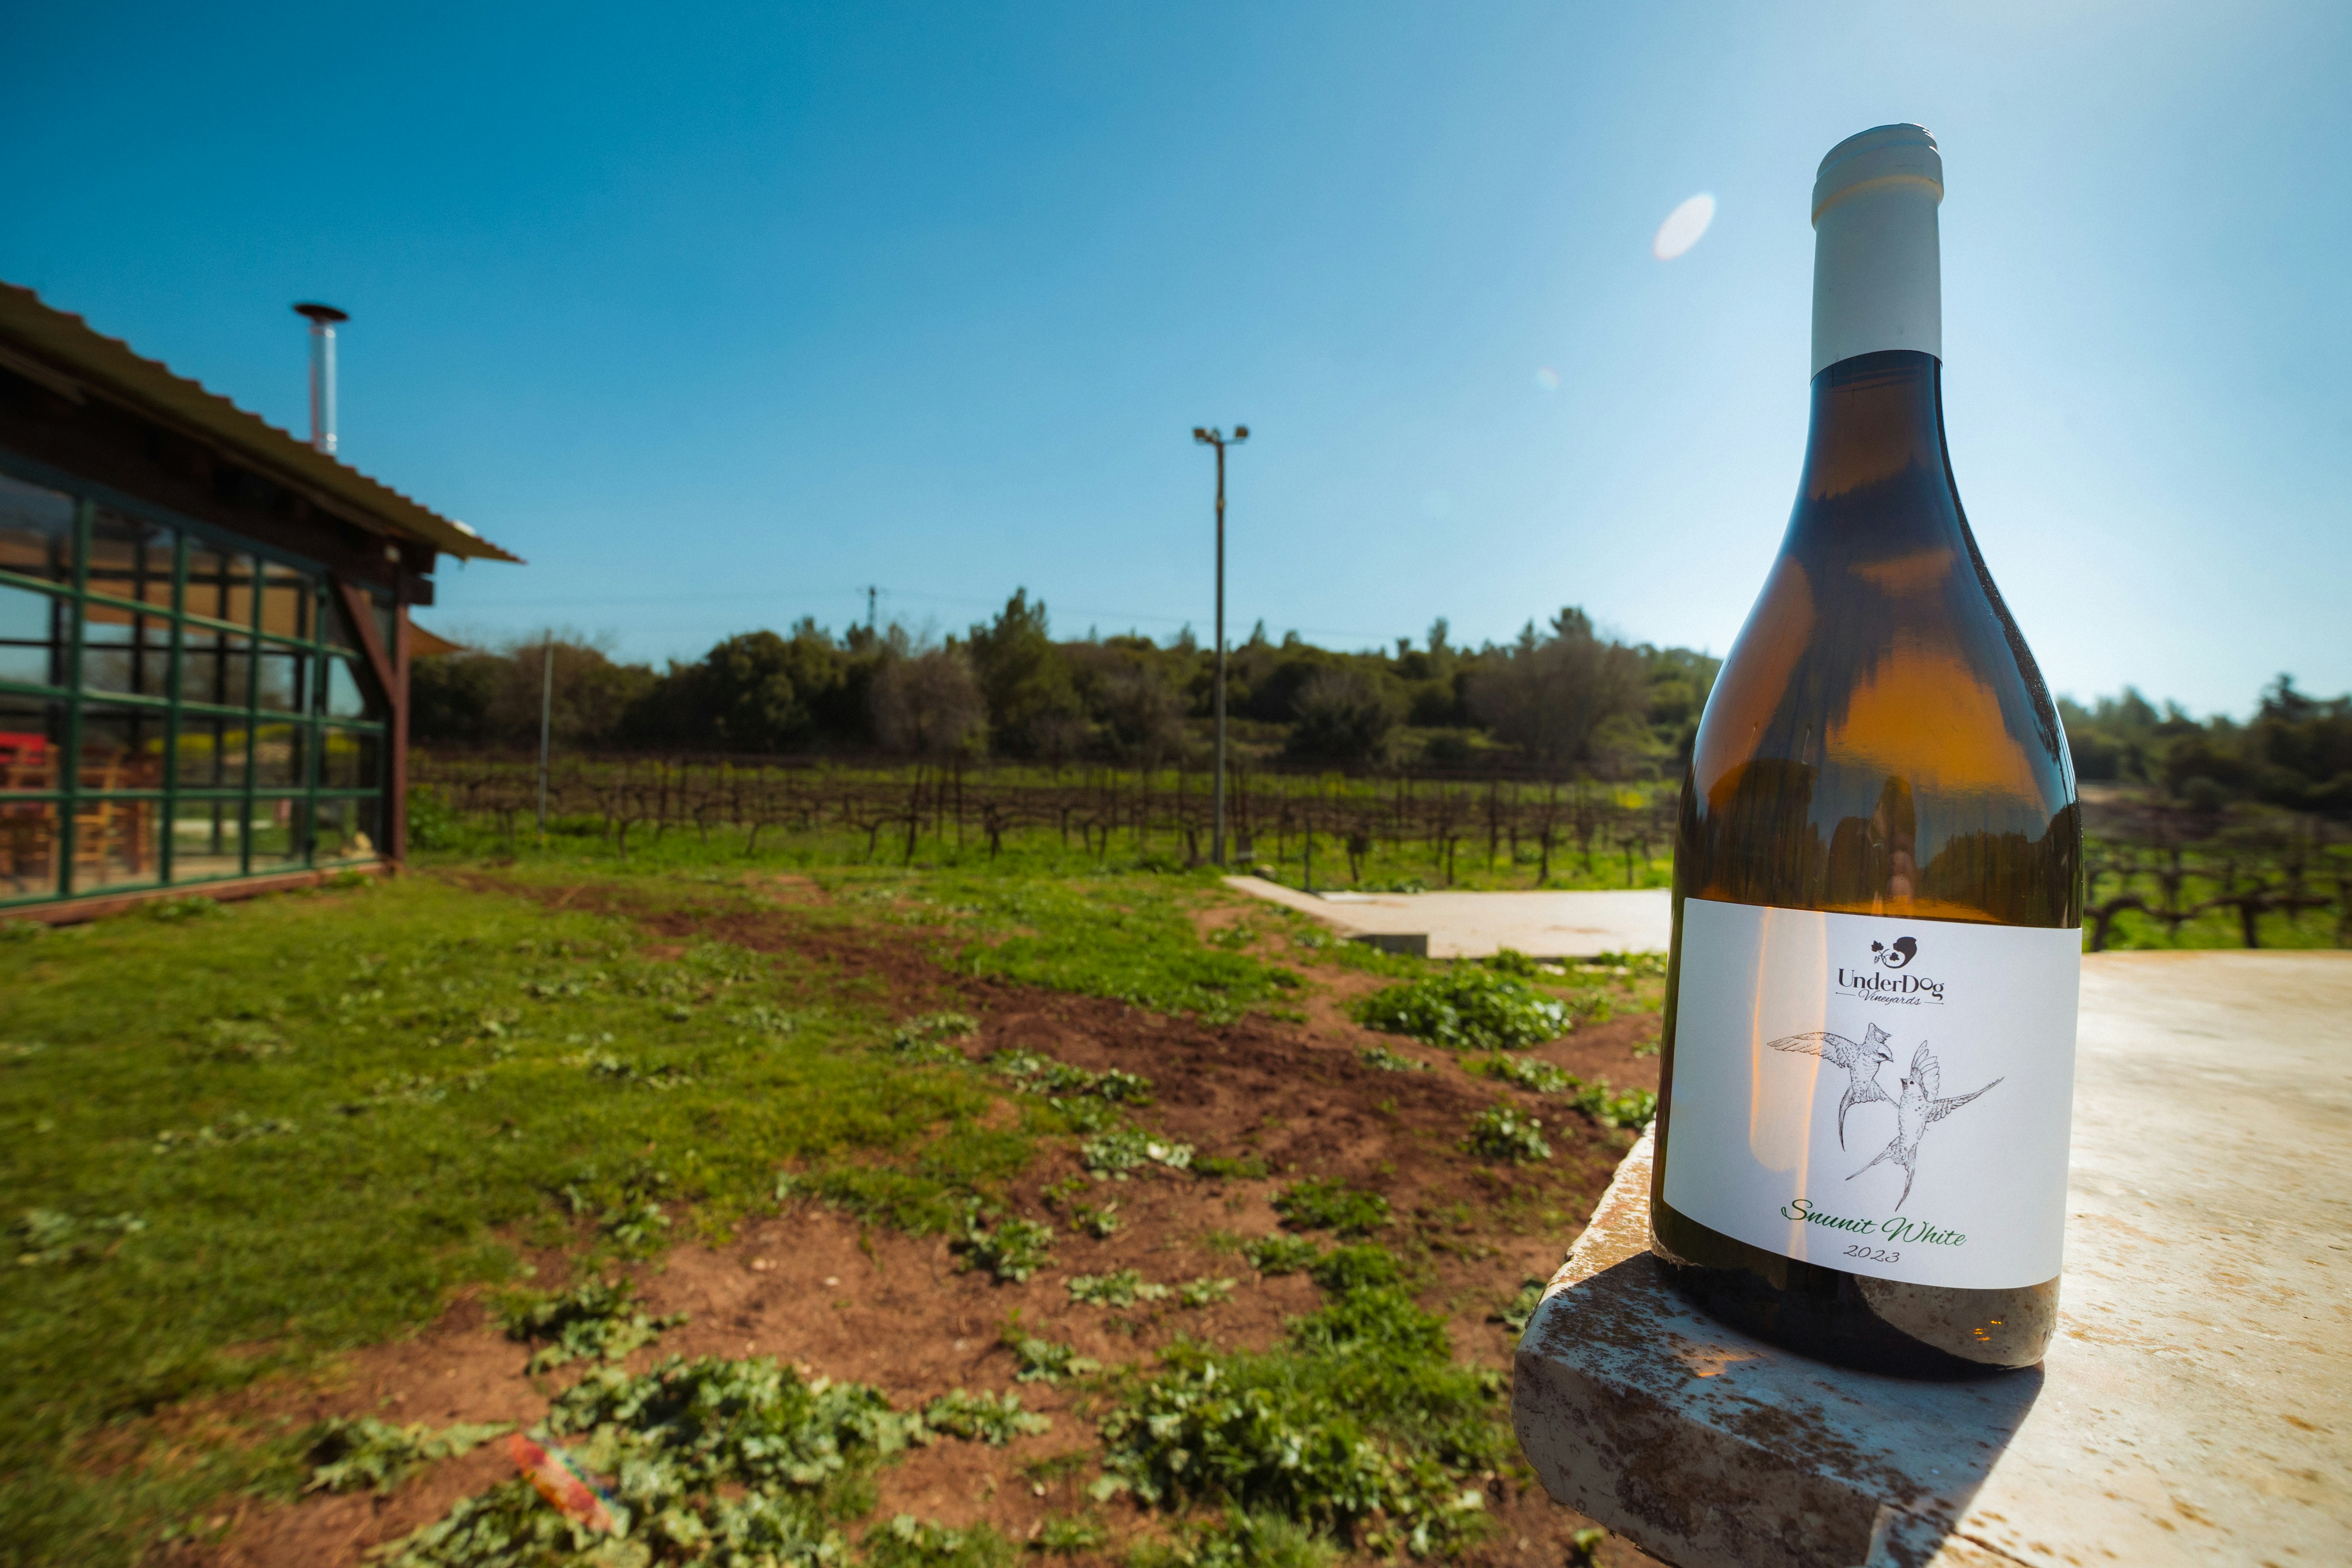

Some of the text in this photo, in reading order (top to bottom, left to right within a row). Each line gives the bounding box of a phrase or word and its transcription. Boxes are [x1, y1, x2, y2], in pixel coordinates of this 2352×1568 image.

[1838, 968, 1944, 1001] UnderDog
[1858, 989, 1921, 1005] Vineyards
[1781, 1199, 1967, 1246] Snunit White
[1843, 1245, 1899, 1263] 2023
